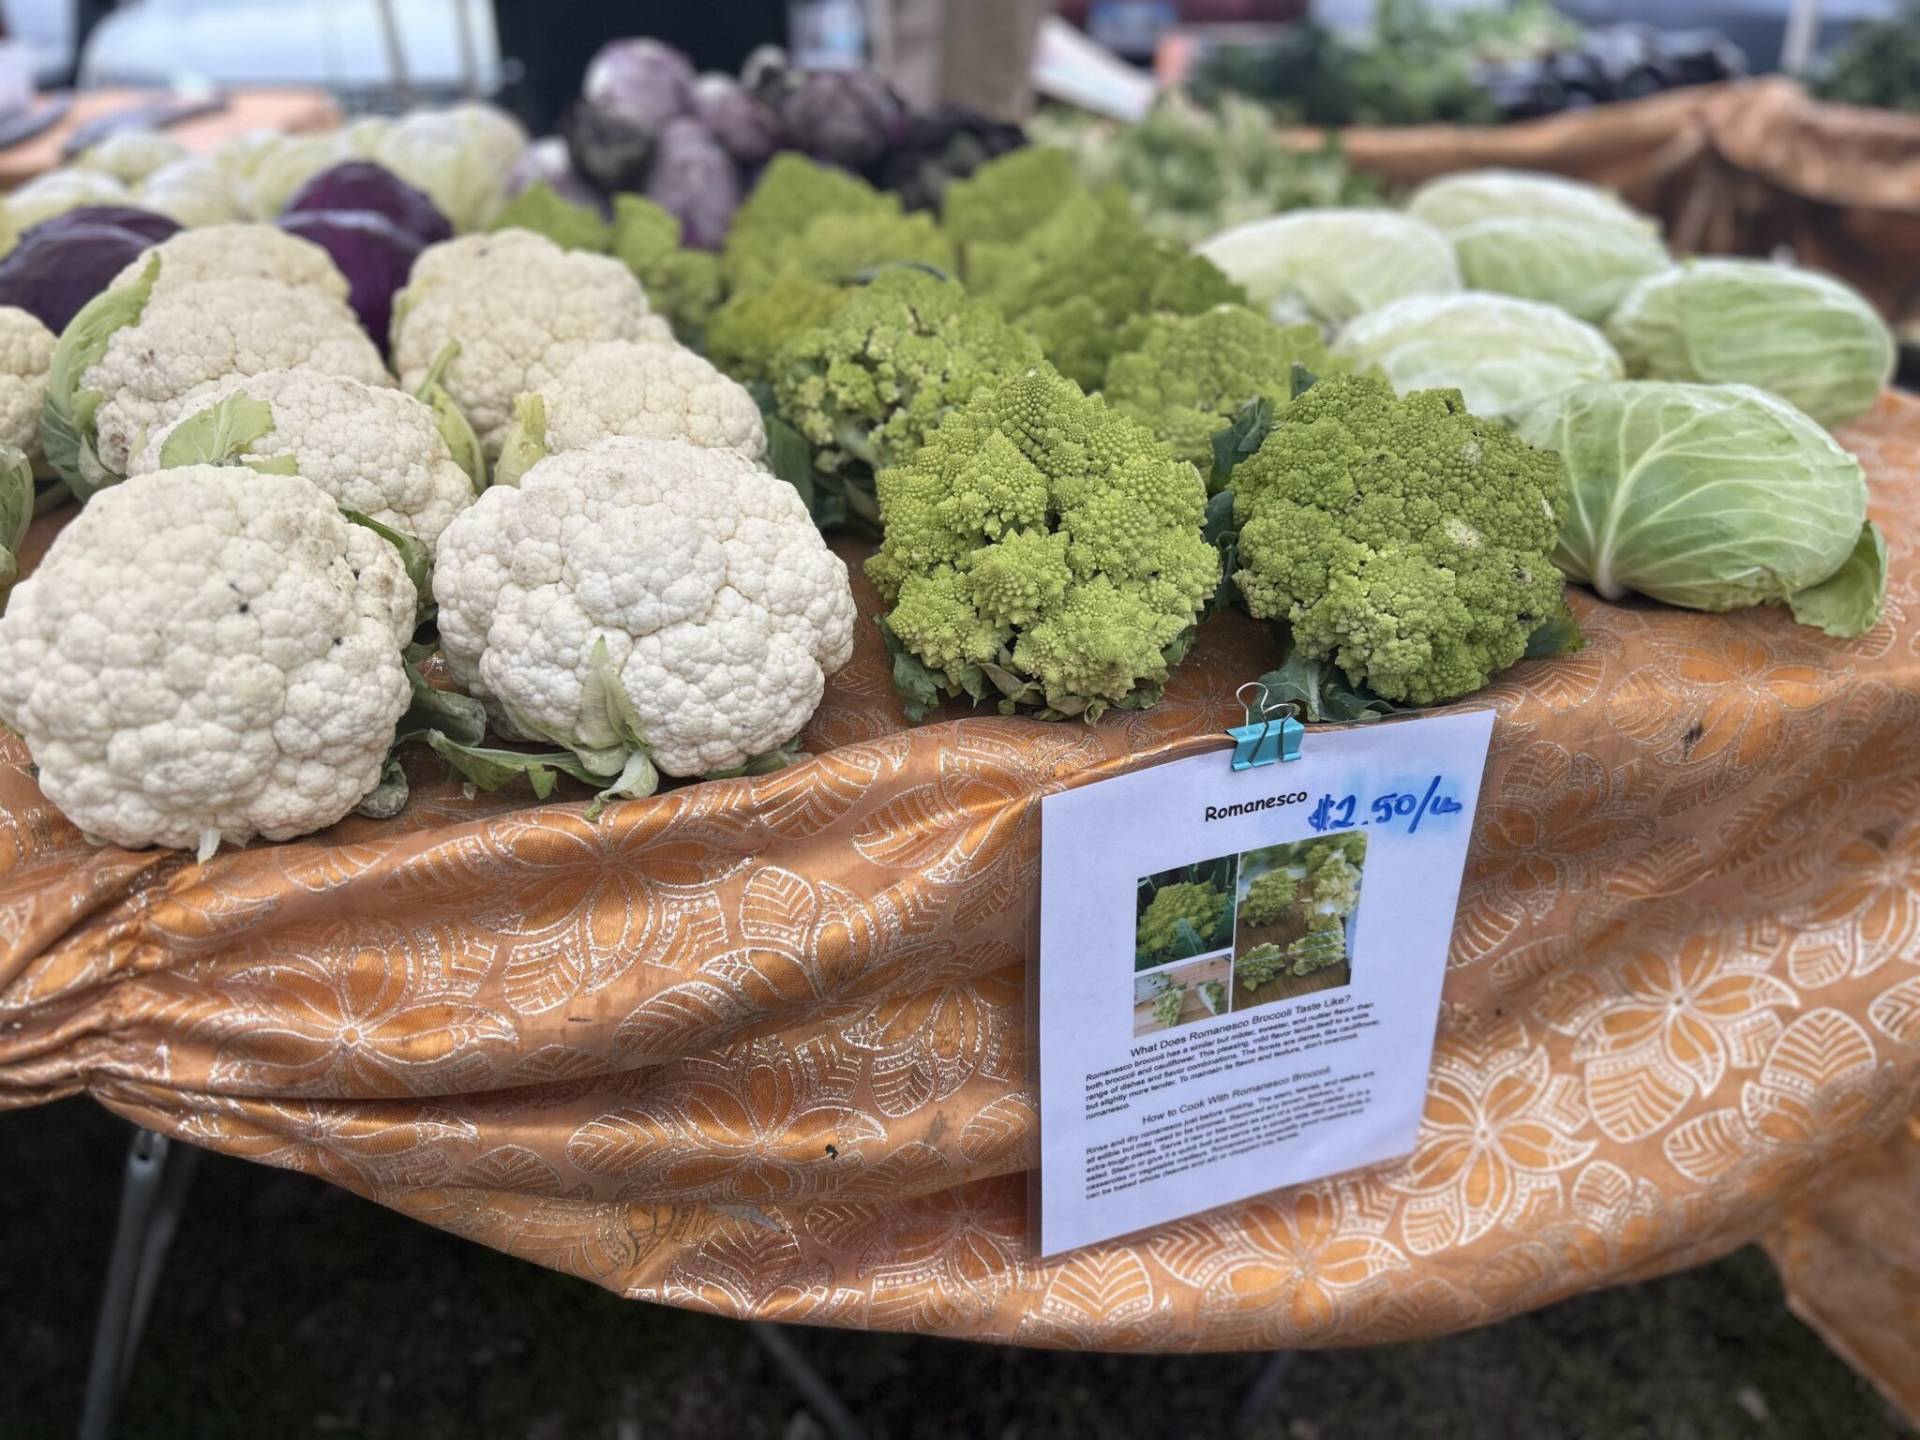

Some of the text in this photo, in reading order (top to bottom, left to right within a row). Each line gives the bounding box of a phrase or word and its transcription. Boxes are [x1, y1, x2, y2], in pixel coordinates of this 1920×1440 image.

[1205, 791, 1307, 822] Romanesco
[1130, 994, 1351, 1057] What Does Romanesco Broccoli Taste Like?
[1086, 1080, 1103, 1091] both
[1105, 1071, 1135, 1086] broccoli
[1138, 1066, 1152, 1076] and
[1199, 1050, 1214, 1059] This
[1087, 1064, 1132, 1081] Romanesco
[1135, 1053, 1165, 1067] broccoli
[1167, 1050, 1180, 1058] has
[1190, 1041, 1214, 1052] similar
[1217, 1036, 1229, 1045] but
[1086, 1102, 1098, 1110] but
[1101, 1093, 1127, 1106] slightly
[1129, 1088, 1148, 1098] more
[1190, 1066, 1222, 1080] maintain
[1236, 1058, 1255, 1067] flavor
[1086, 1090, 1108, 1101] range
[1120, 1079, 1145, 1091] dishes
[1148, 1073, 1161, 1083] and
[1164, 1068, 1185, 1078] flavor
[1143, 1113, 1165, 1124] How
[1179, 1100, 1205, 1114] Cook
[1208, 1093, 1229, 1106] With
[1232, 1078, 1290, 1098] Romanesco
[1292, 1066, 1331, 1082] Broccoli
